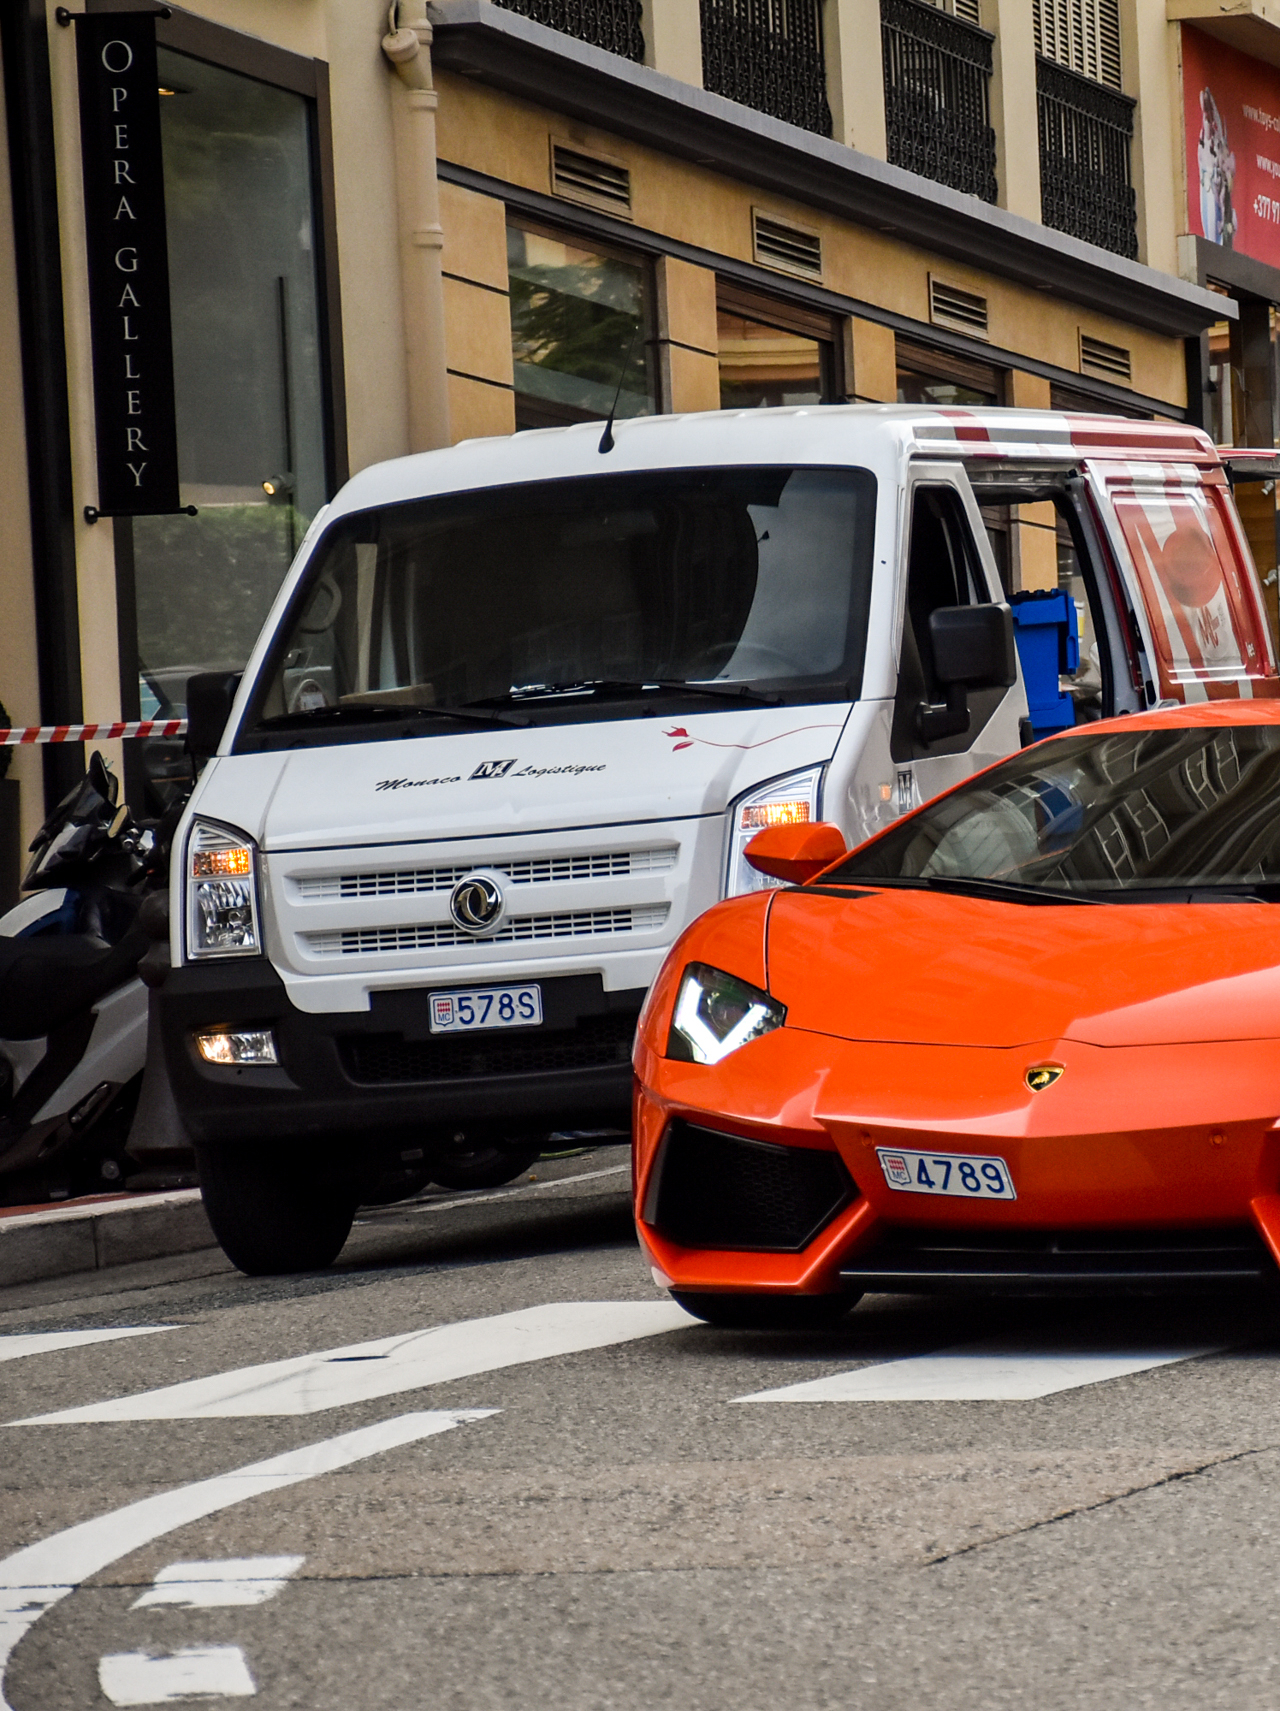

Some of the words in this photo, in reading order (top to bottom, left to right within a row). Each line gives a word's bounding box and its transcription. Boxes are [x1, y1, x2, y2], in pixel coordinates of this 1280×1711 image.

[101, 41, 137, 220] OPERA
[1253, 194, 1271, 220] +377
[1272, 200, 1280, 224] 97
[115, 247, 149, 487] GALLERY
[375, 775, 461, 792] Monaco
[510, 764, 607, 779] Logistique
[438, 1011, 451, 1022] MC
[457, 991, 535, 1025] 578S
[892, 1170, 908, 1182] MC
[917, 1158, 1005, 1194] 4789
